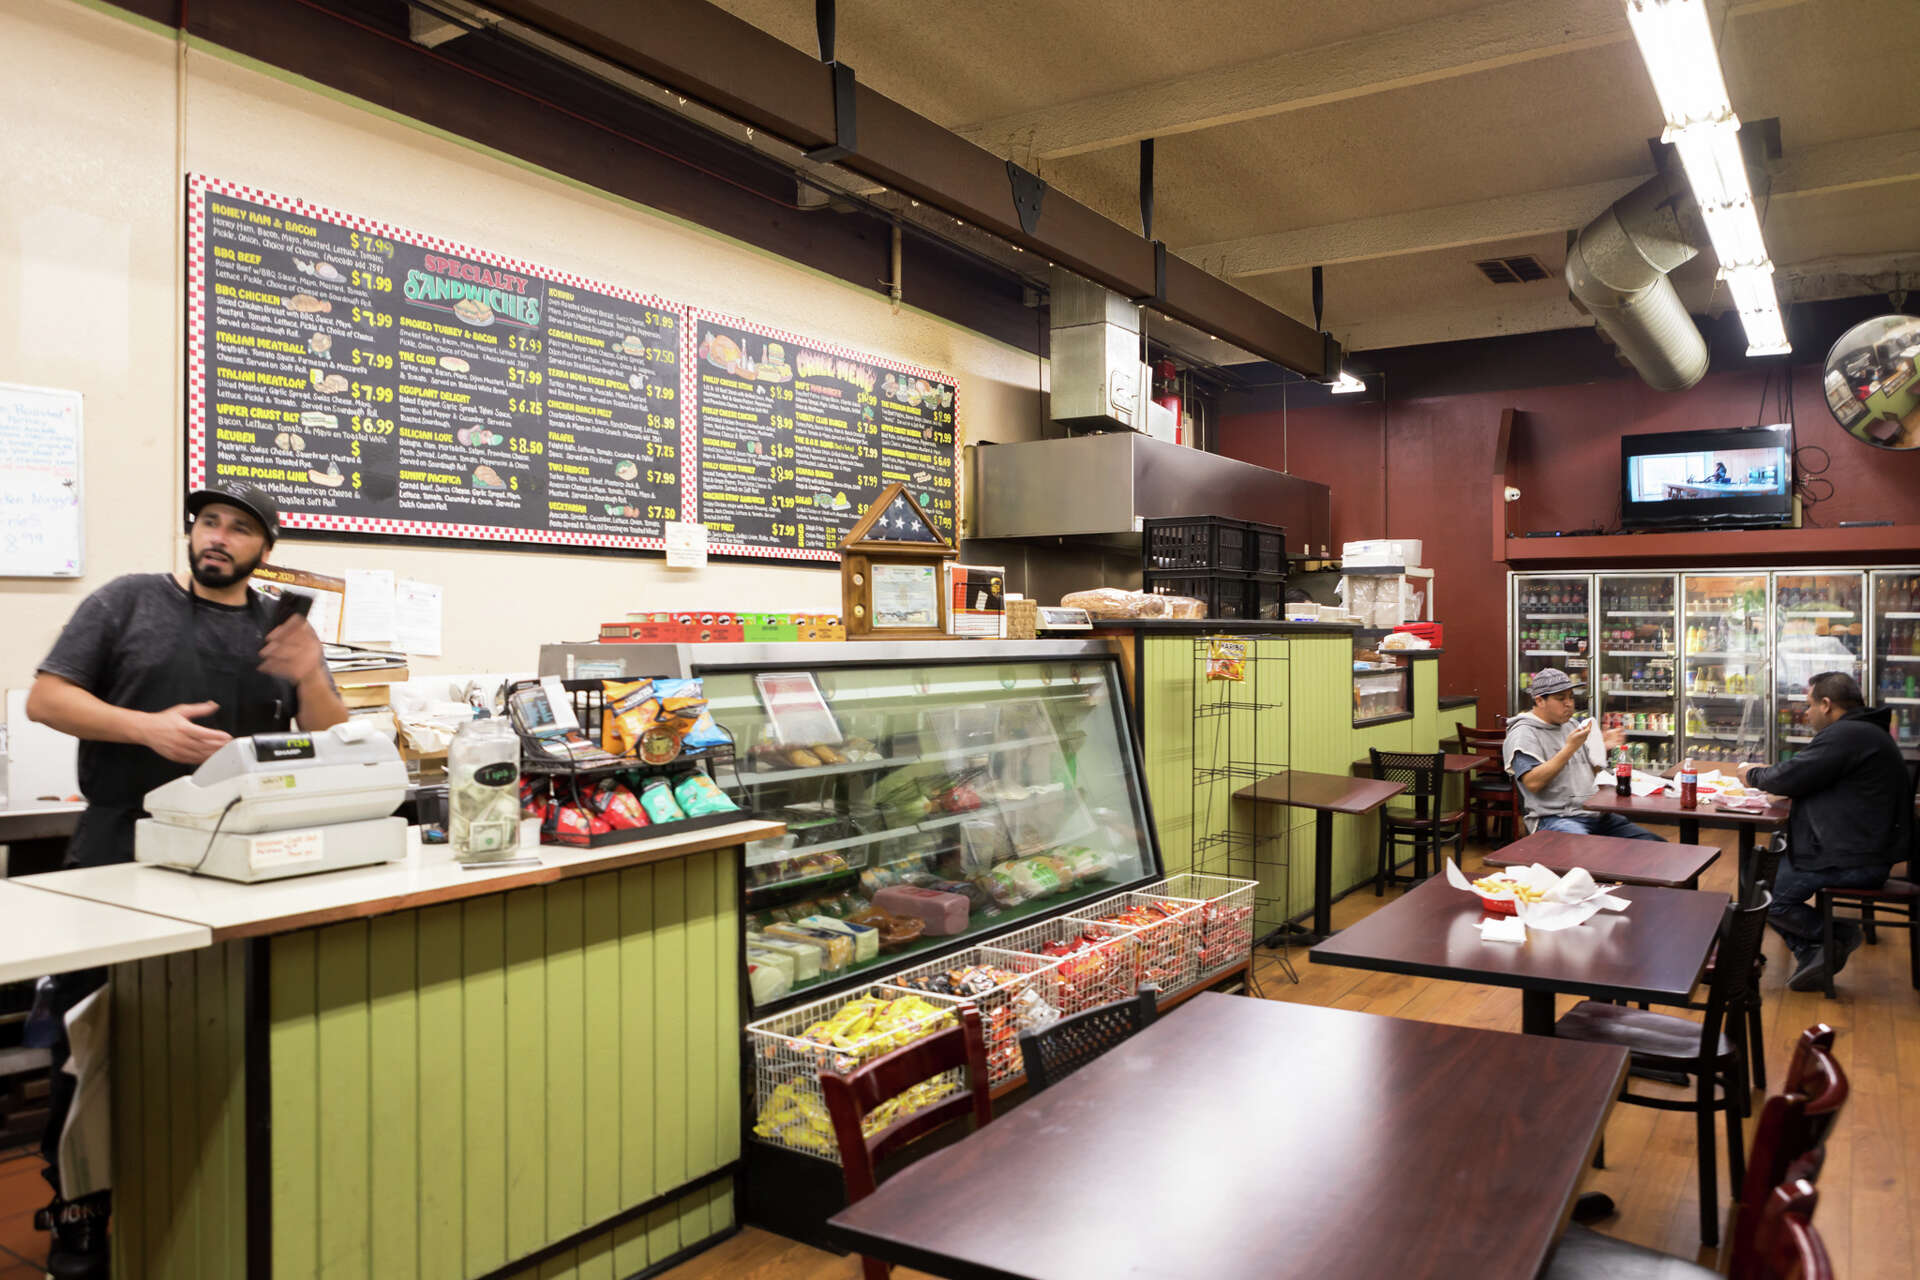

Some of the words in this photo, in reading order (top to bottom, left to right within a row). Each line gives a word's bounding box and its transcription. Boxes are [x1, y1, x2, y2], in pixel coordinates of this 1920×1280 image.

[212, 202, 246, 221] HONEY
[249, 211, 270, 227] HAM
[285, 220, 316, 238] BACON
[213, 245, 234, 260] BBQ
[237, 250, 261, 266] BEEF
[424, 254, 528, 293] SPECIALTY
[215, 283, 236, 298] BBQ
[238, 287, 280, 306] CHICKEN
[403, 270, 539, 327] SANDWICHES
[399, 316, 432, 332] SMOKED
[433, 323, 462, 337] TURKEY
[472, 331, 497, 344] BACON
[216, 330, 254, 347] ITALIAN
[257, 337, 305, 355] MEATBALL
[416, 353, 436, 366] CLUB
[217, 366, 255, 382] ITALIAN
[257, 372, 306, 390] MEATLOAF
[216, 402, 248, 417] UPPER
[250, 407, 280, 421] CRUST
[216, 428, 255, 443] REUBEN
[216, 464, 249, 477] SUPER
[251, 467, 285, 480] POLISH
[287, 470, 308, 482] LINK
